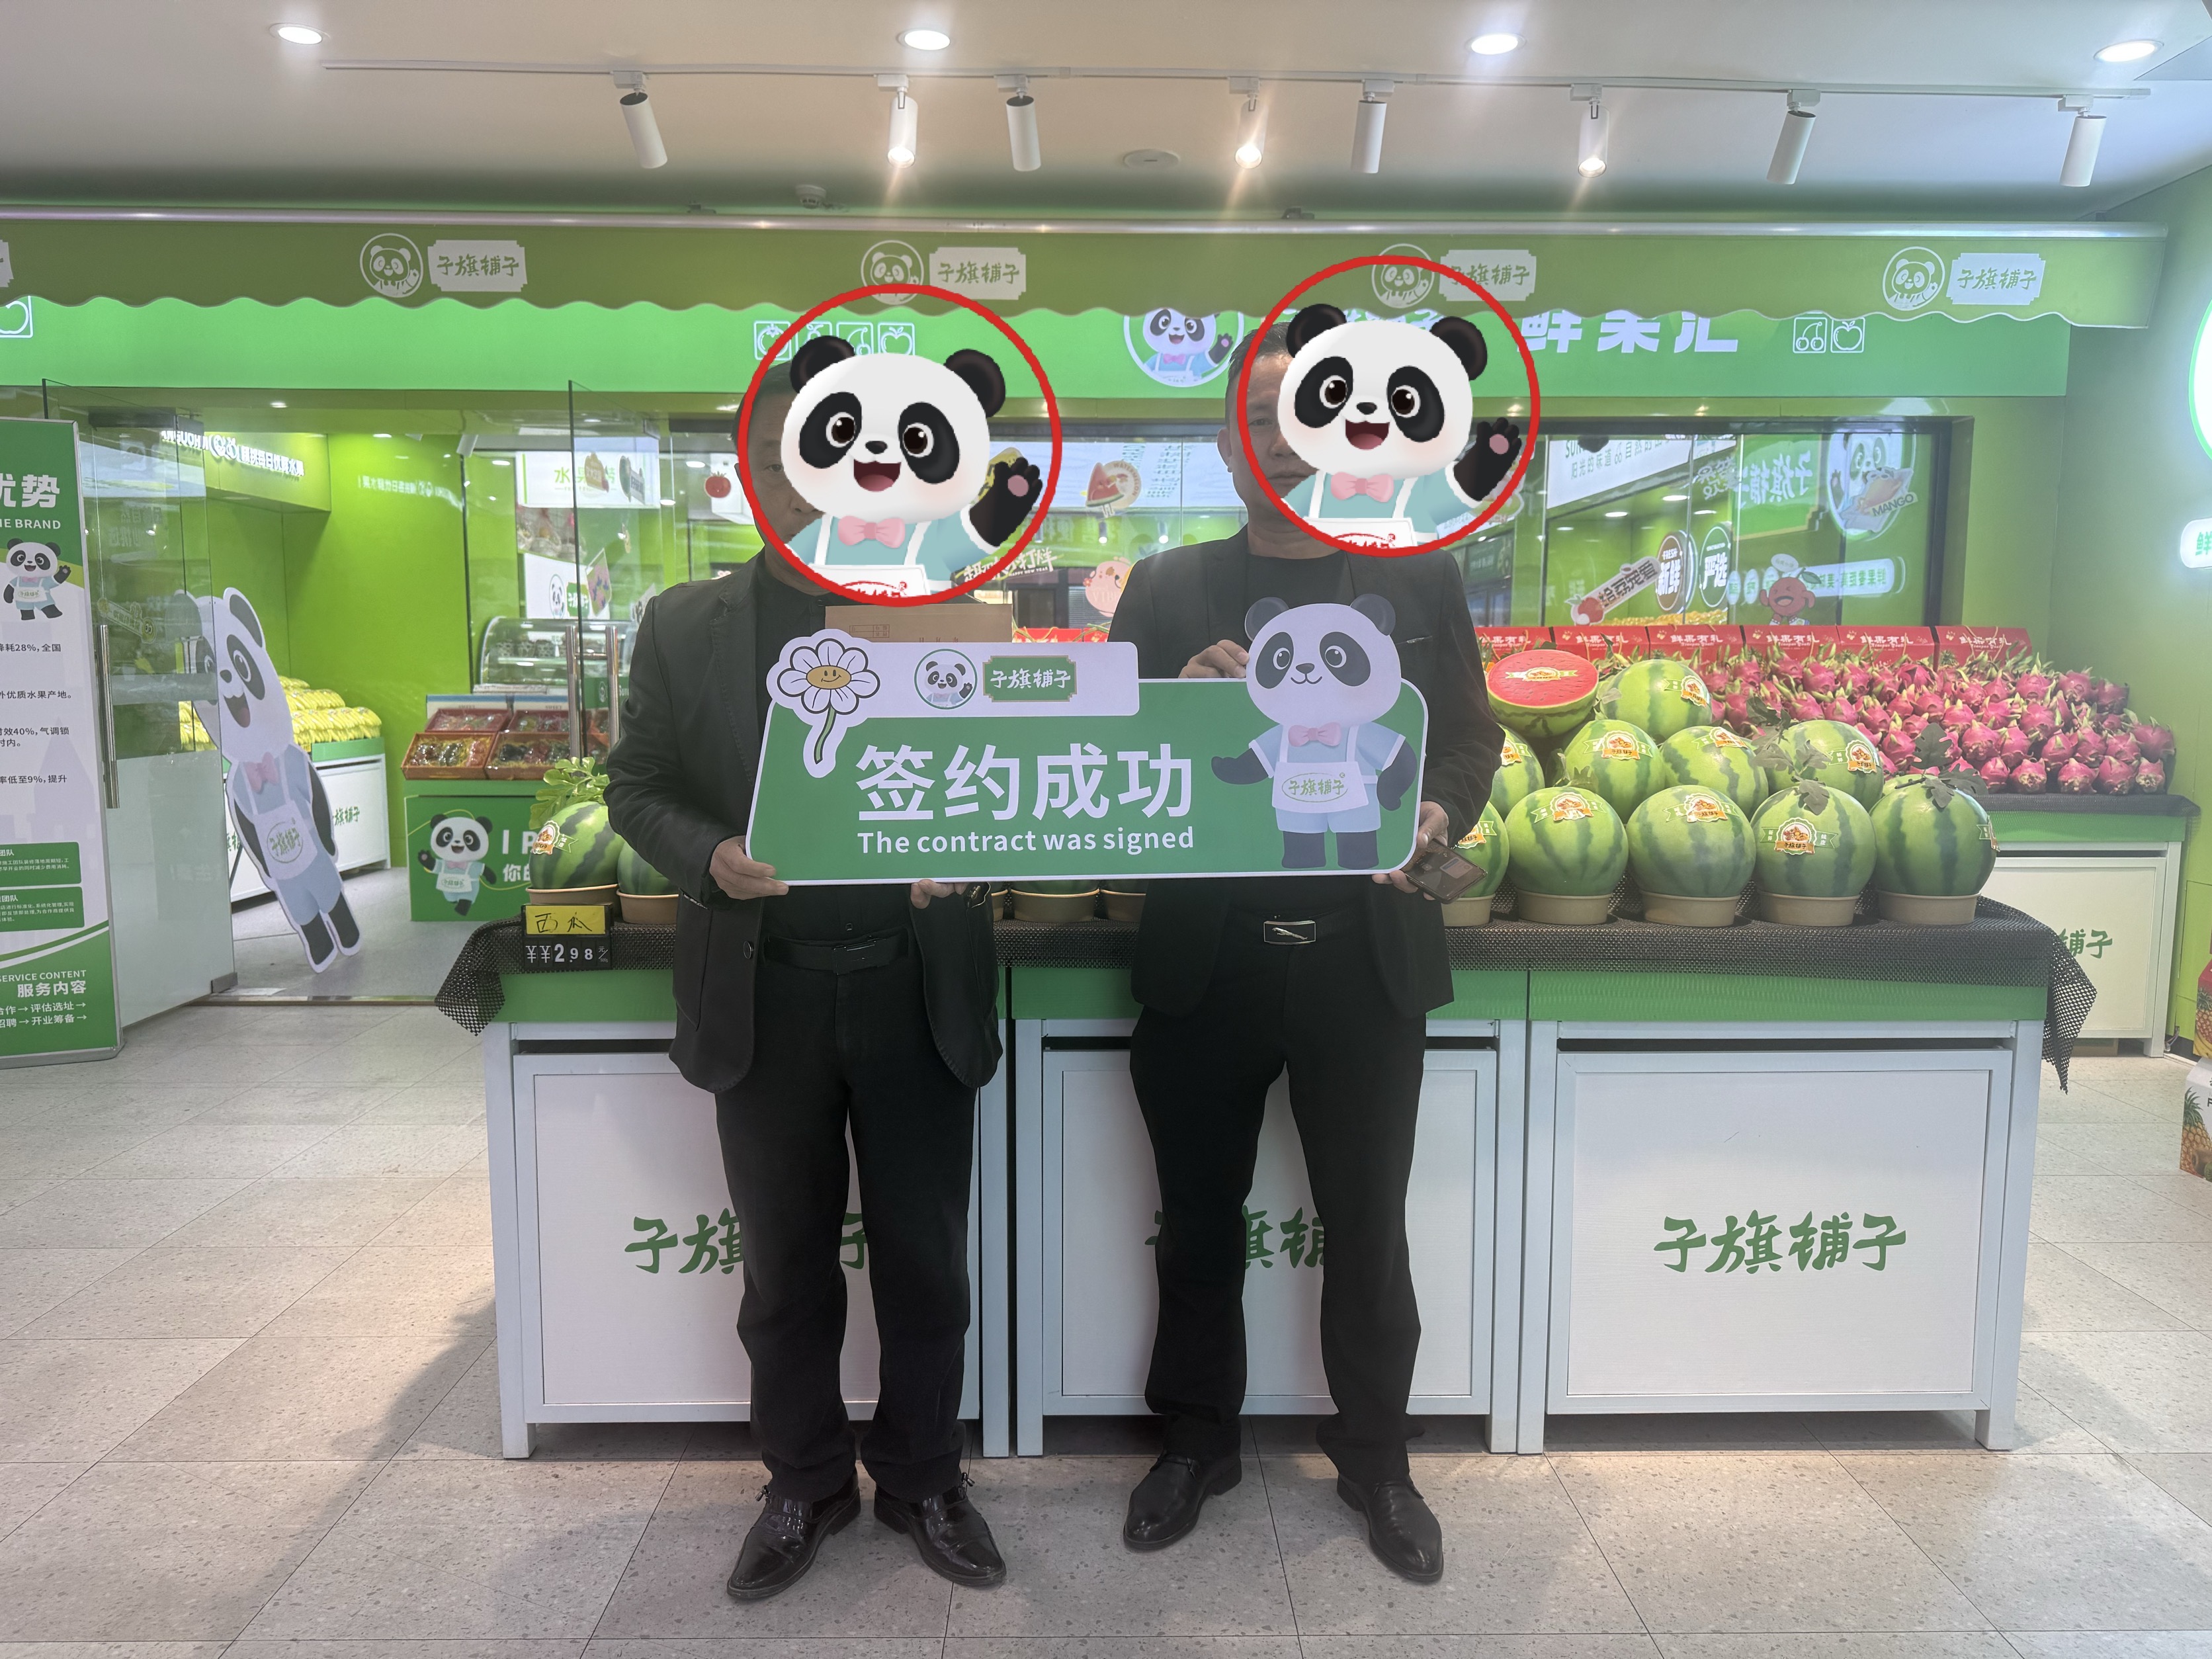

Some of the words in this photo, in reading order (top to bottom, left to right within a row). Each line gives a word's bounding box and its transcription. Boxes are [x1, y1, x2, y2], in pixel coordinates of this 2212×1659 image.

[437, 254, 519, 277] 子旗铺子
[938, 261, 1019, 284] 子旗铺子
[1957, 267, 2037, 290] 子旗铺子
[1872, 493, 1914, 516] MANGO
[15, 519, 61, 529] BRAND
[1703, 552, 1727, 590] 严选
[1670, 634, 1724, 644] 鲜果有礼
[990, 667, 1070, 689] 子旗铺子
[855, 742, 1191, 821] 签约成功
[1289, 779, 1345, 796] 子旗铺子
[333, 806, 361, 826] 旗铺子
[857, 831, 910, 853] The
[917, 830, 1037, 853] contract
[1042, 833, 1096, 851] was
[1103, 826, 1193, 855] signed
[0, 973, 37, 982] ERVICE
[39, 970, 87, 980] CONTENT
[17, 980, 87, 998] 服务内容
[30, 1001, 74, 1013] 评估选址
[32, 1014, 75, 1025] 开业筹备
[1654, 1210, 1906, 1274] 子旗铺子
